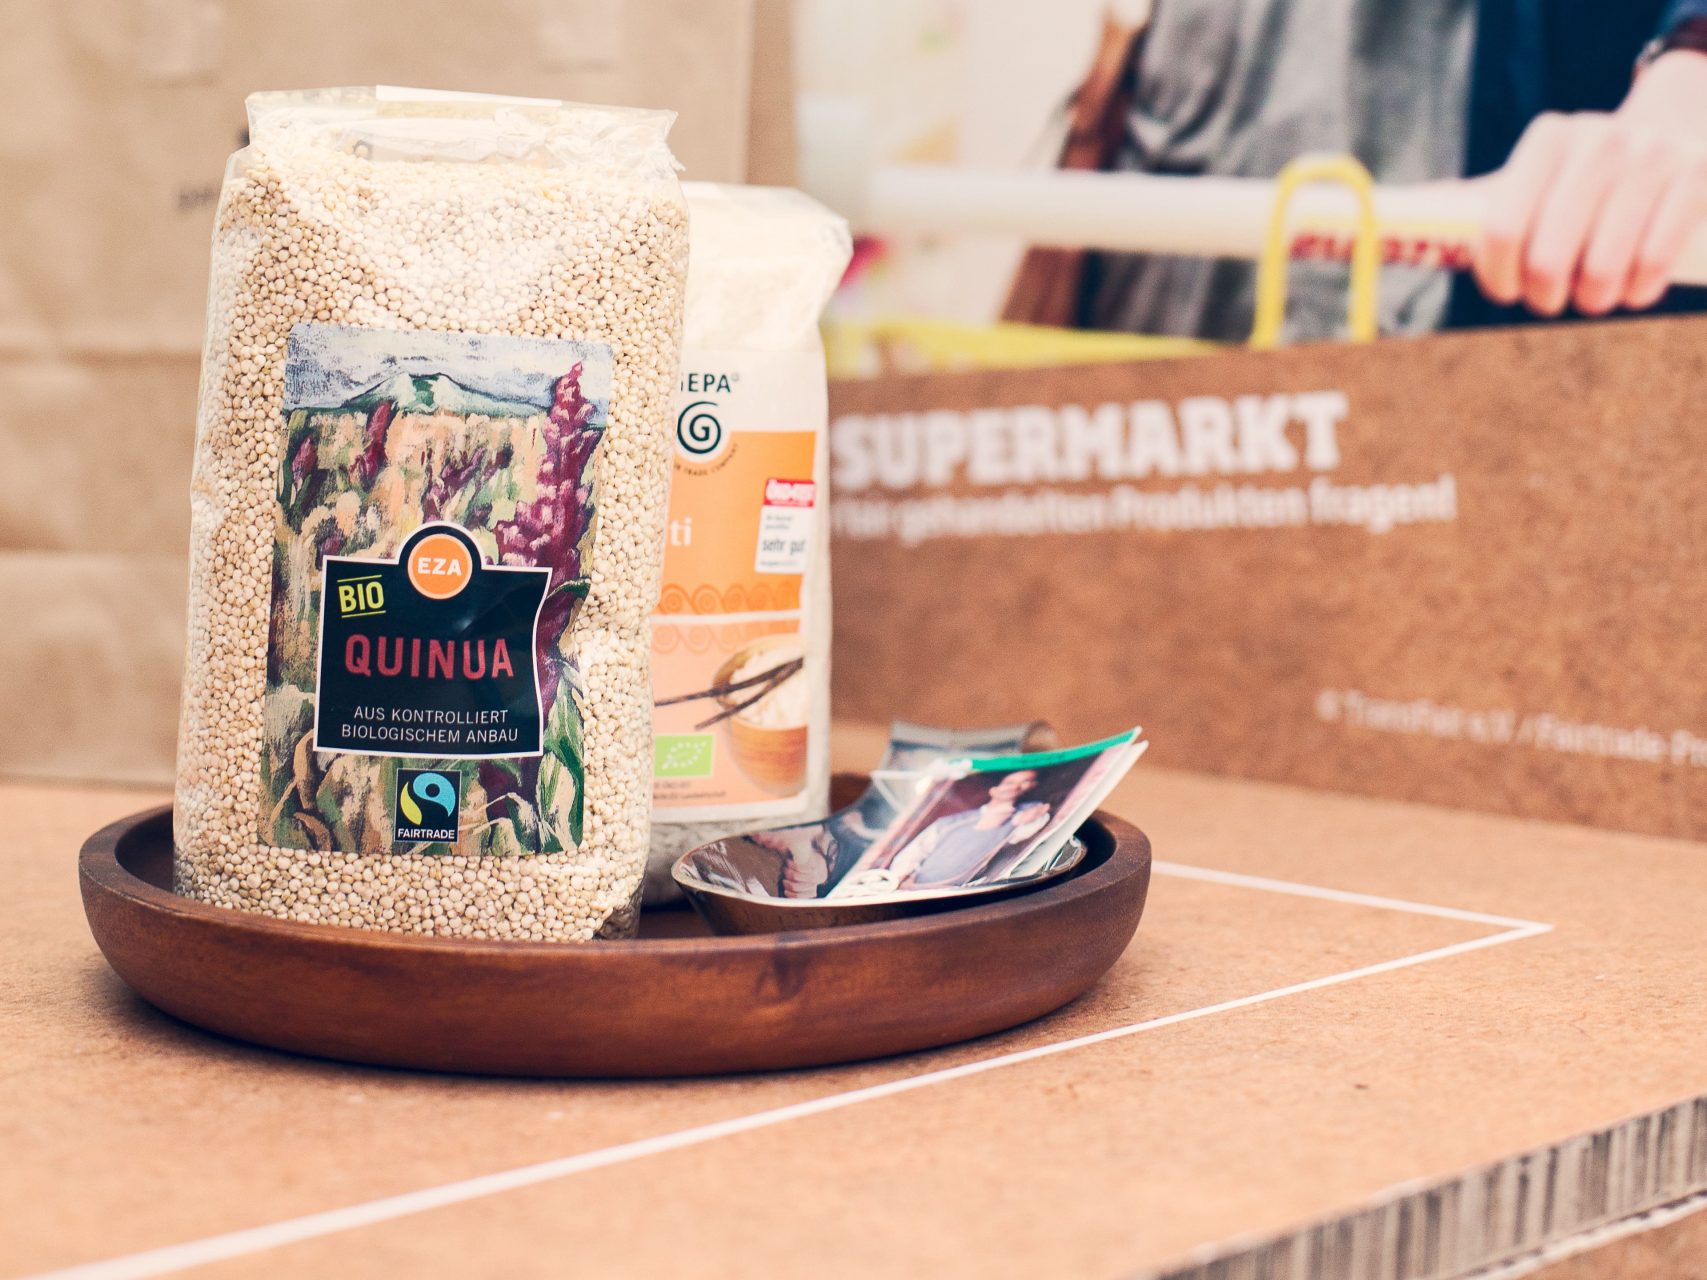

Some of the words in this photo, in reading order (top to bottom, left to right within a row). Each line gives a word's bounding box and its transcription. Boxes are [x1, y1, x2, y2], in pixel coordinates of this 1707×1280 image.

[831, 391, 1347, 488] SUPERMARKT
[1110, 481, 1305, 533] Produkten
[1308, 473, 1455, 534] fragen!
[417, 556, 463, 577] EZA
[338, 581, 385, 613] BIO
[345, 634, 515, 679] QUINUA
[354, 705, 385, 721] AUS
[392, 708, 508, 725] KONTROLLIERT
[341, 723, 460, 743] BIOLOGISCHEM
[466, 728, 518, 743] ANBAU
[397, 828, 455, 840] FAIRTRADE
